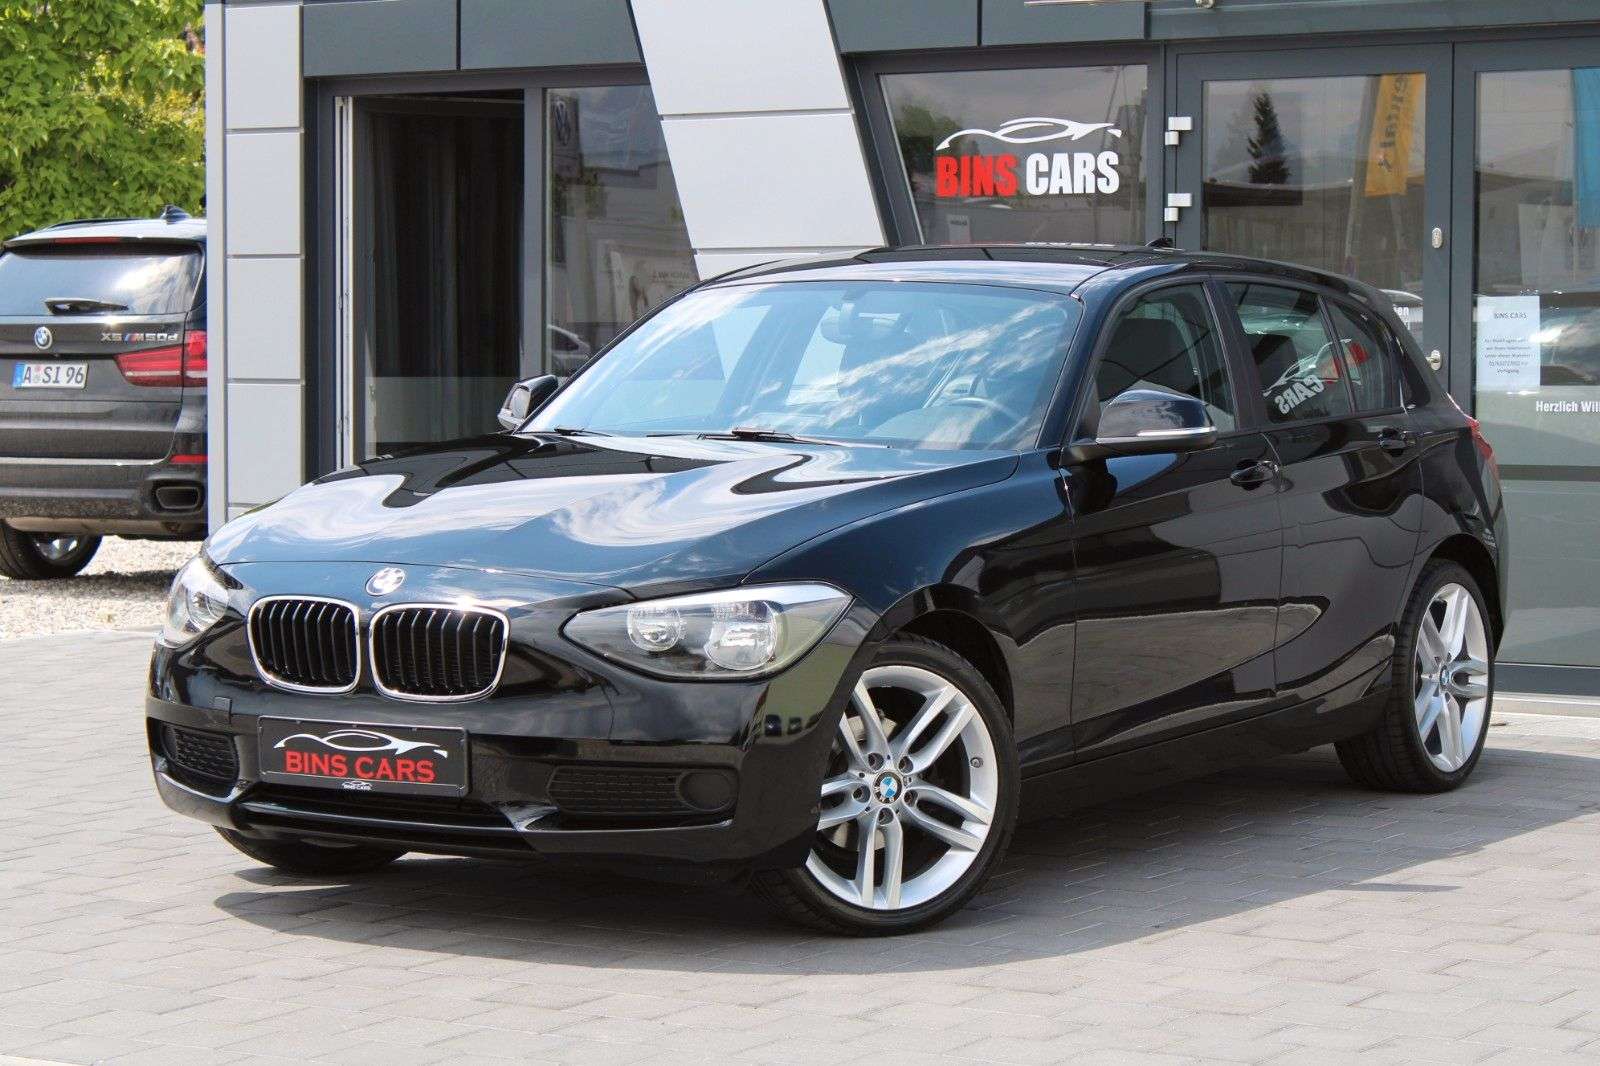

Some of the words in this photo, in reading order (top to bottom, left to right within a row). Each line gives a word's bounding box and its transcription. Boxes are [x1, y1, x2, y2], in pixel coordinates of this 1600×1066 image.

[936, 154, 1019, 197] BINS
[1026, 151, 1120, 195] CARS
[101, 333, 122, 342] X5
[23, 363, 32, 384] A
[42, 365, 61, 384] SI
[66, 365, 84, 384] 96
[1535, 400, 1578, 413] Herzlich
[284, 750, 348, 778] BINS
[354, 756, 437, 783] CARS
